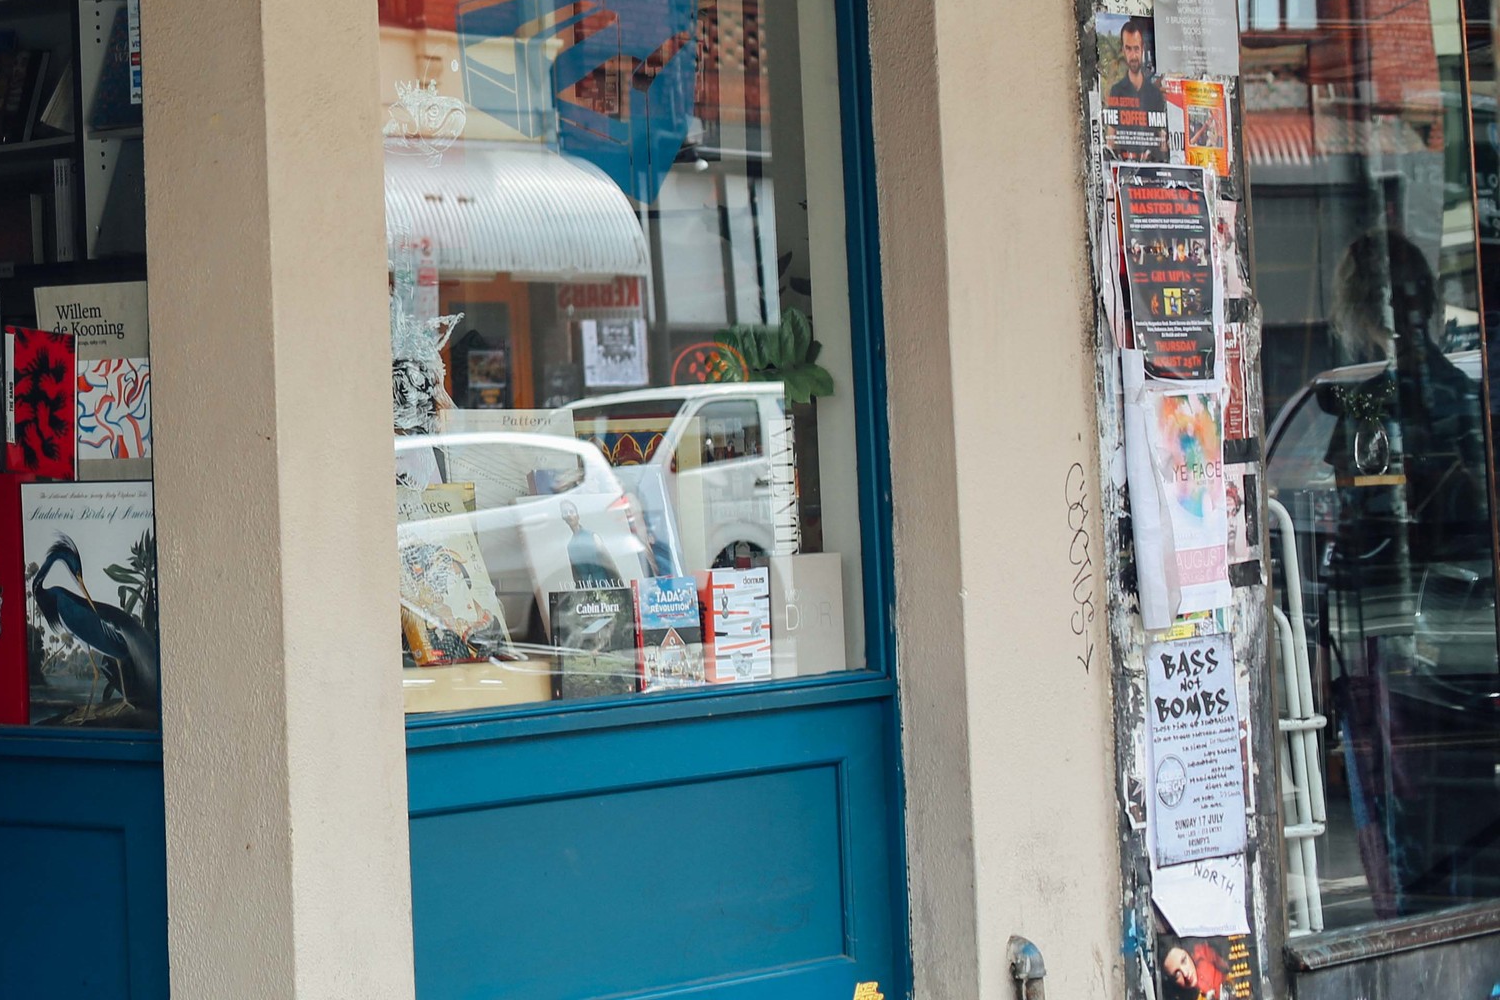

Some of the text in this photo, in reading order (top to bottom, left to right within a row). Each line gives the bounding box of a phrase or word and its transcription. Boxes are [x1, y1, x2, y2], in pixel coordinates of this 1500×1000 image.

[1102, 109, 1167, 127] THE COFFEE MAN
[1128, 187, 1178, 200] THINKING
[1179, 188, 1189, 200] OF
[1130, 202, 1200, 215] MASTER PLAN
[55, 303, 102, 320] Willem
[53, 320, 125, 340] de Kooning
[1155, 340, 1197, 352] THURSDAY
[502, 414, 552, 427] Pattern
[1192, 461, 1222, 480] FACE
[30, 505, 154, 524] Audubon's Birds of Ameri
[1176, 547, 1223, 571] AUGUST
[743, 576, 764, 585] domus
[576, 602, 620, 615] Cabin Porn
[1160, 647, 1219, 680] BASS
[1154, 688, 1230, 723] BOMBS
[1174, 813, 1224, 831] SUNDAY 17 JULY
[1193, 860, 1235, 897] NORTH
